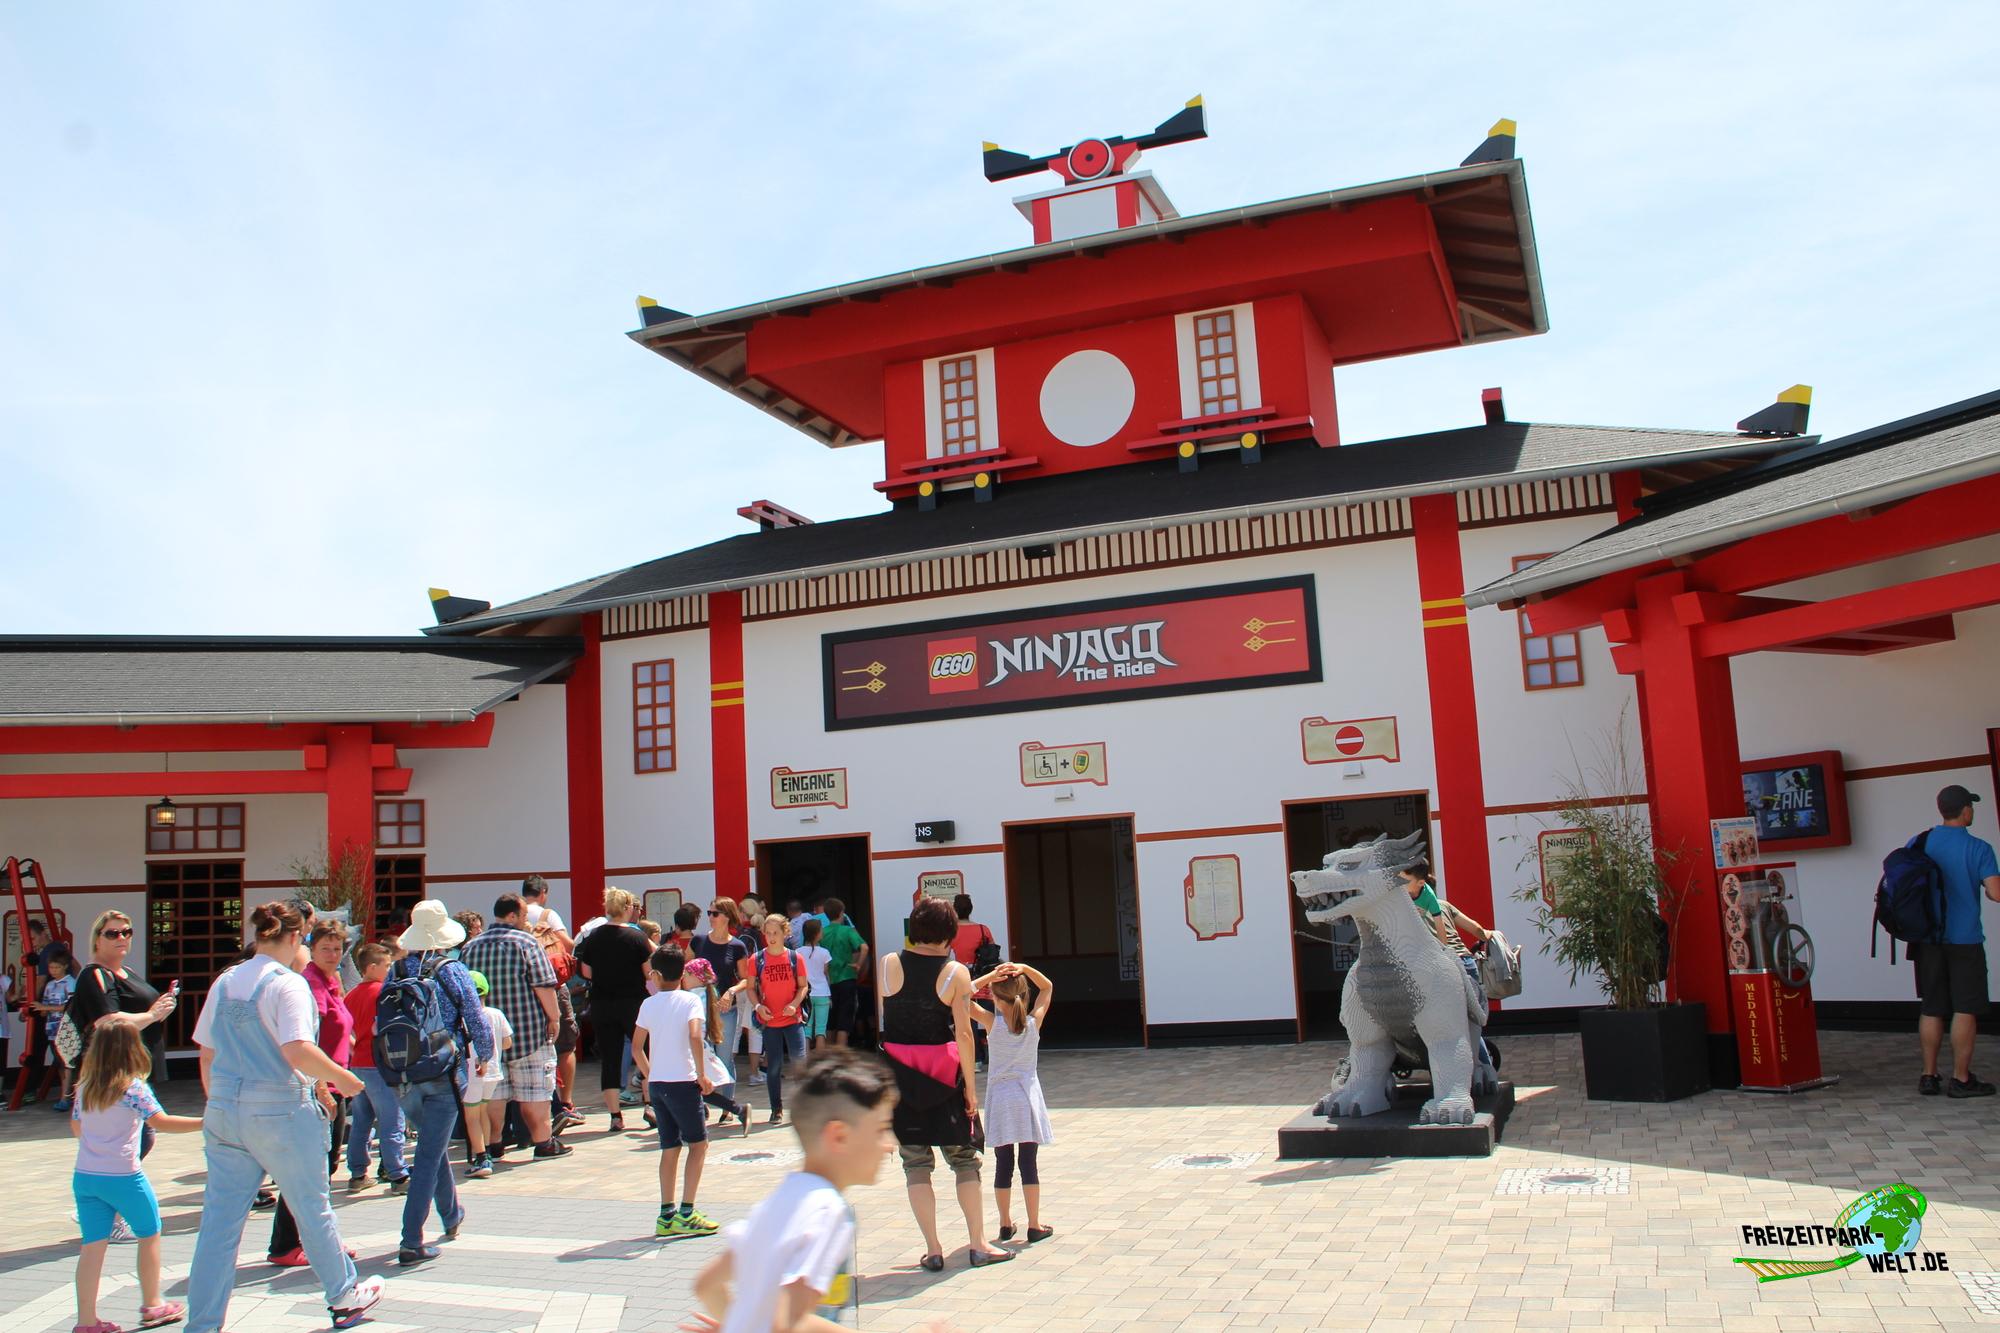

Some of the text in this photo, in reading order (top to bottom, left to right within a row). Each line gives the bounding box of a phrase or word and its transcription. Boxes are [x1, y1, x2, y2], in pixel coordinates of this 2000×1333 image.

[930, 621, 1178, 687] LEGO NINJAGO
[1072, 662, 1156, 682] The Ride
[789, 791, 829, 803] ENTRANCE
[1772, 788, 1814, 811] ZANE
[764, 963, 792, 975] SPORT
[1745, 983, 1761, 1064] MEDAILLEN
[1773, 980, 1788, 1062] MEDAILLEN
